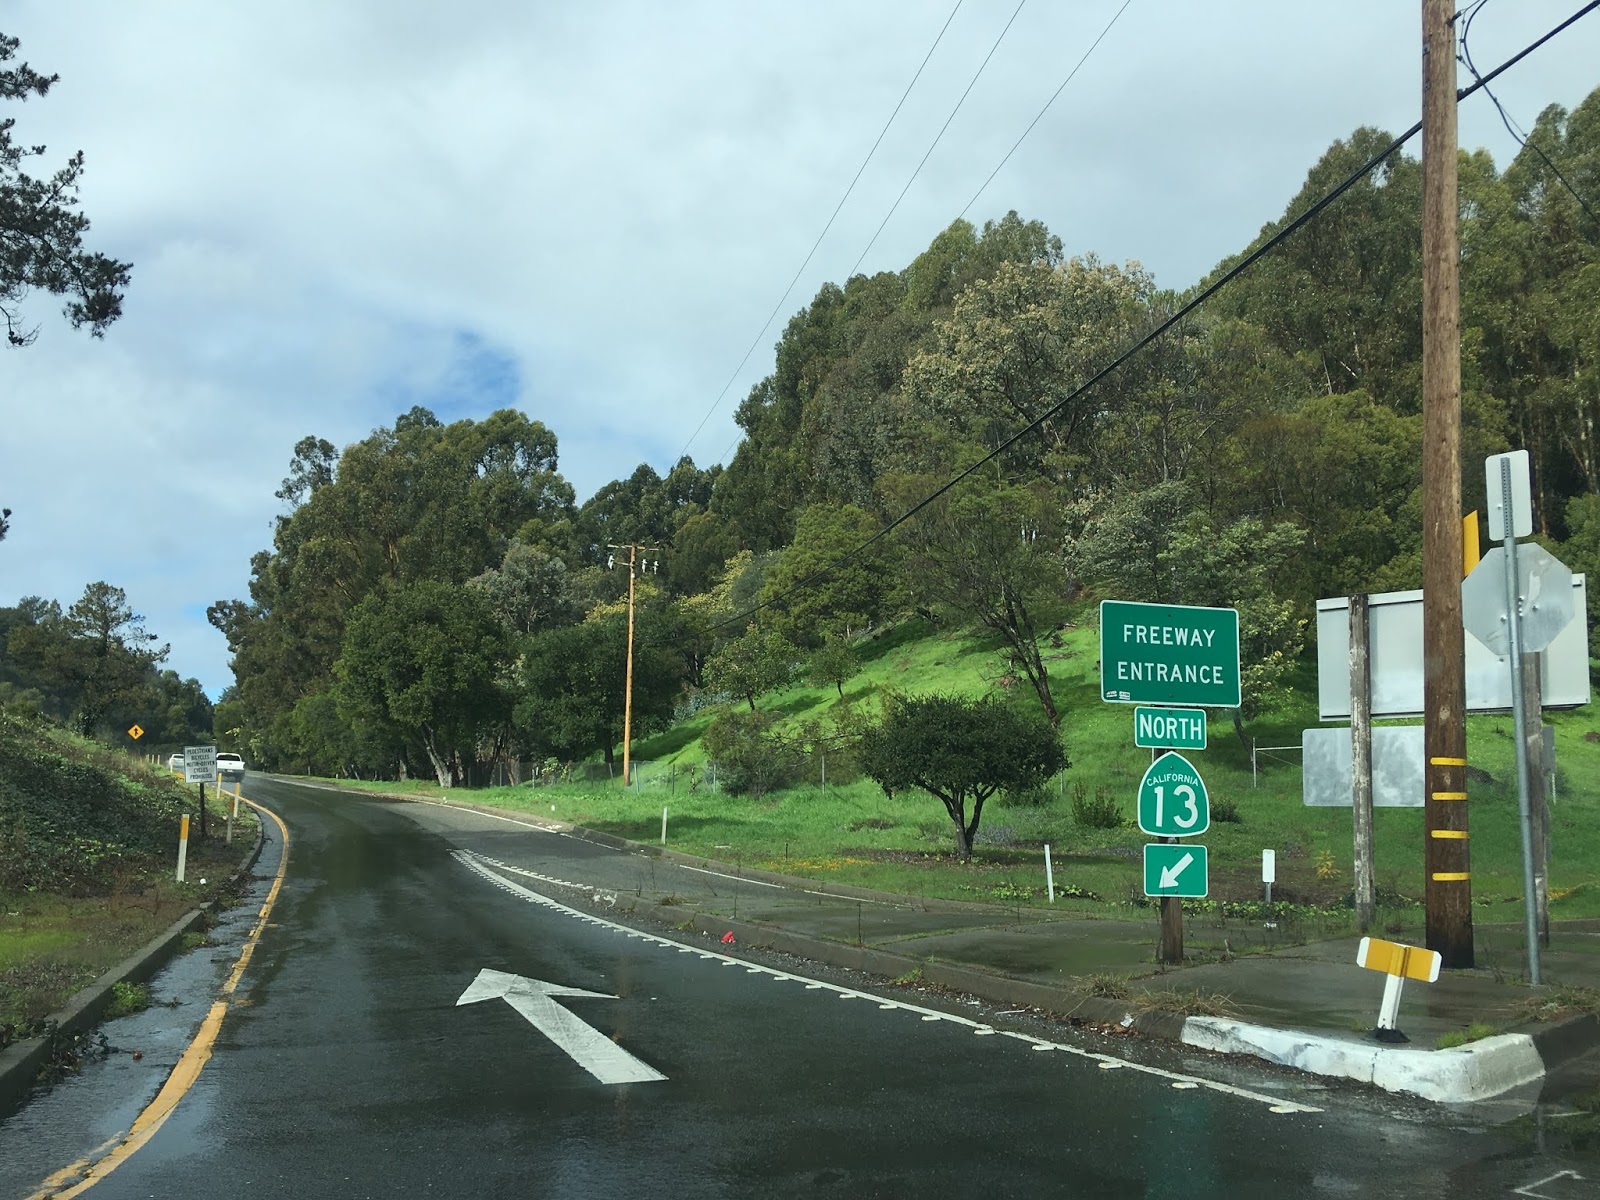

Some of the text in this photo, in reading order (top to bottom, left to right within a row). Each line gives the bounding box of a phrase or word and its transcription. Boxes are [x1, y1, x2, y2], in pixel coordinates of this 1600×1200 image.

[1123, 624, 1216, 647] FREEWAY
[1117, 661, 1224, 684] ENTRANCE
[1139, 714, 1202, 741] NORTH
[1146, 773, 1199, 787] CALIFORNIA
[1154, 784, 1199, 828] 13
